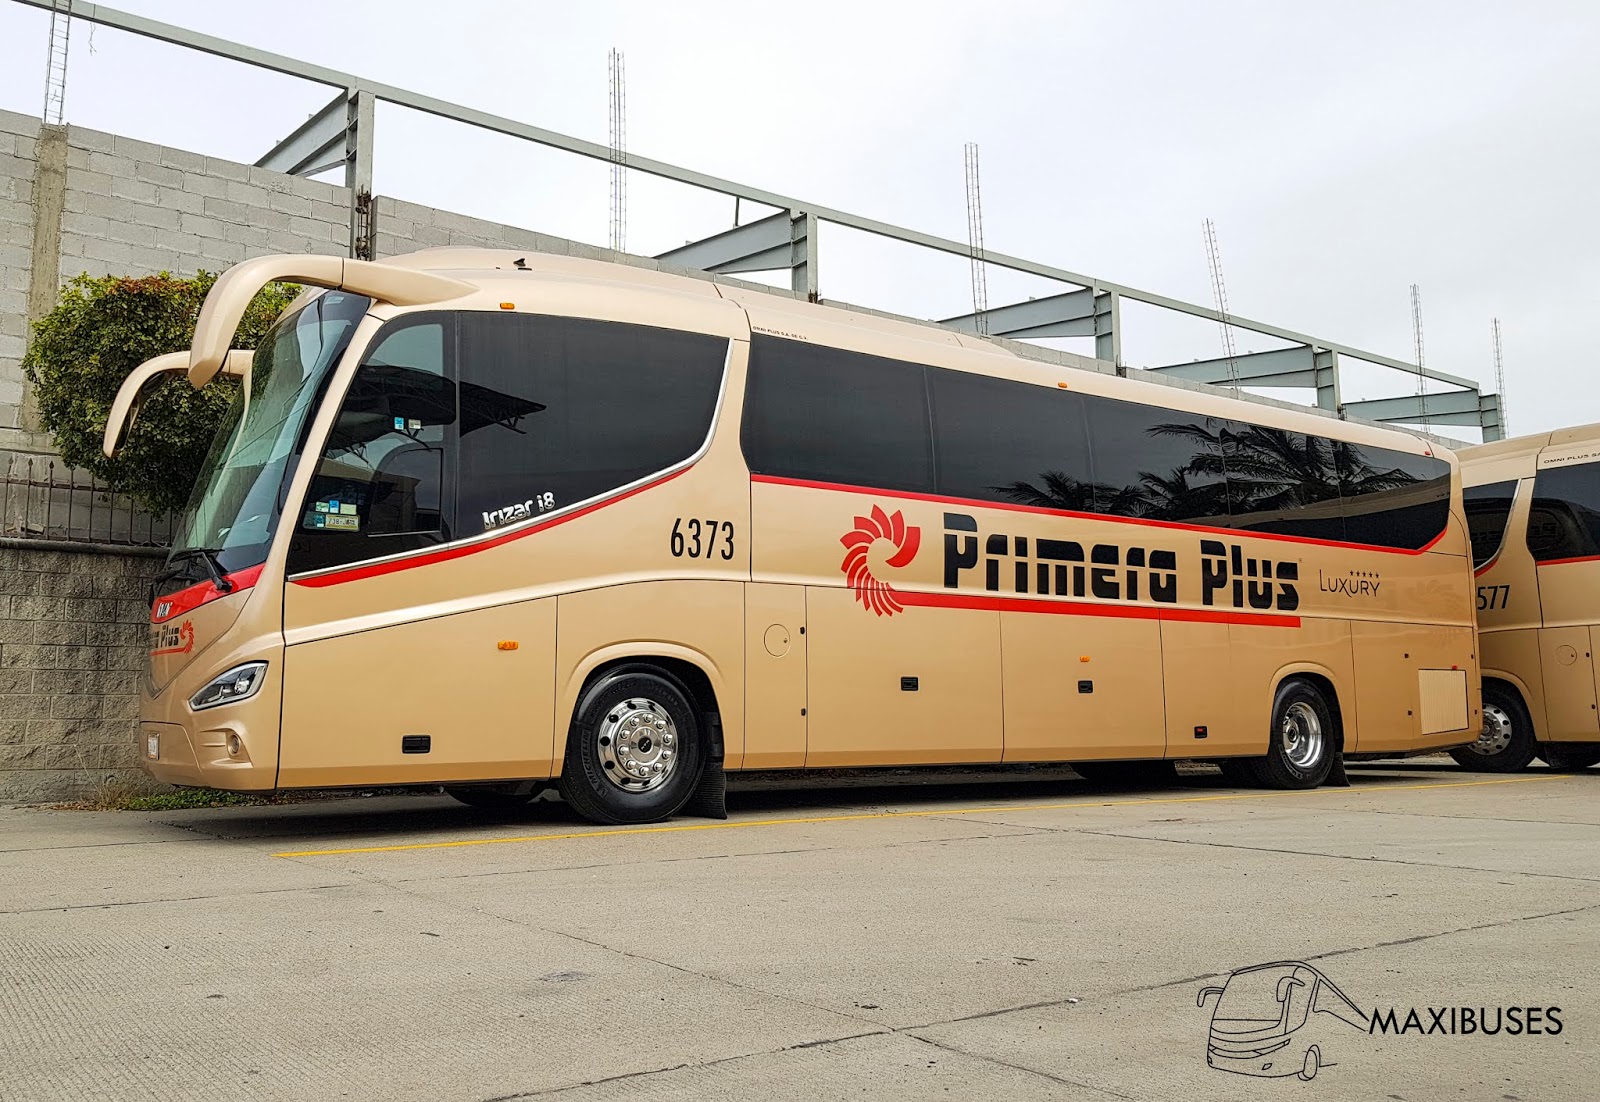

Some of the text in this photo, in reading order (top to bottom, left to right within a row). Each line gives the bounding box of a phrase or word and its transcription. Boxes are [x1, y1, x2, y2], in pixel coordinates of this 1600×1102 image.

[482, 492, 555, 530] Irizar i8
[671, 518, 734, 560] 6373
[943, 512, 1300, 611] Primera Plus
[1319, 569, 1380, 598] LUXURY
[1477, 585, 1511, 610] 577
[160, 625, 179, 648] Plus
